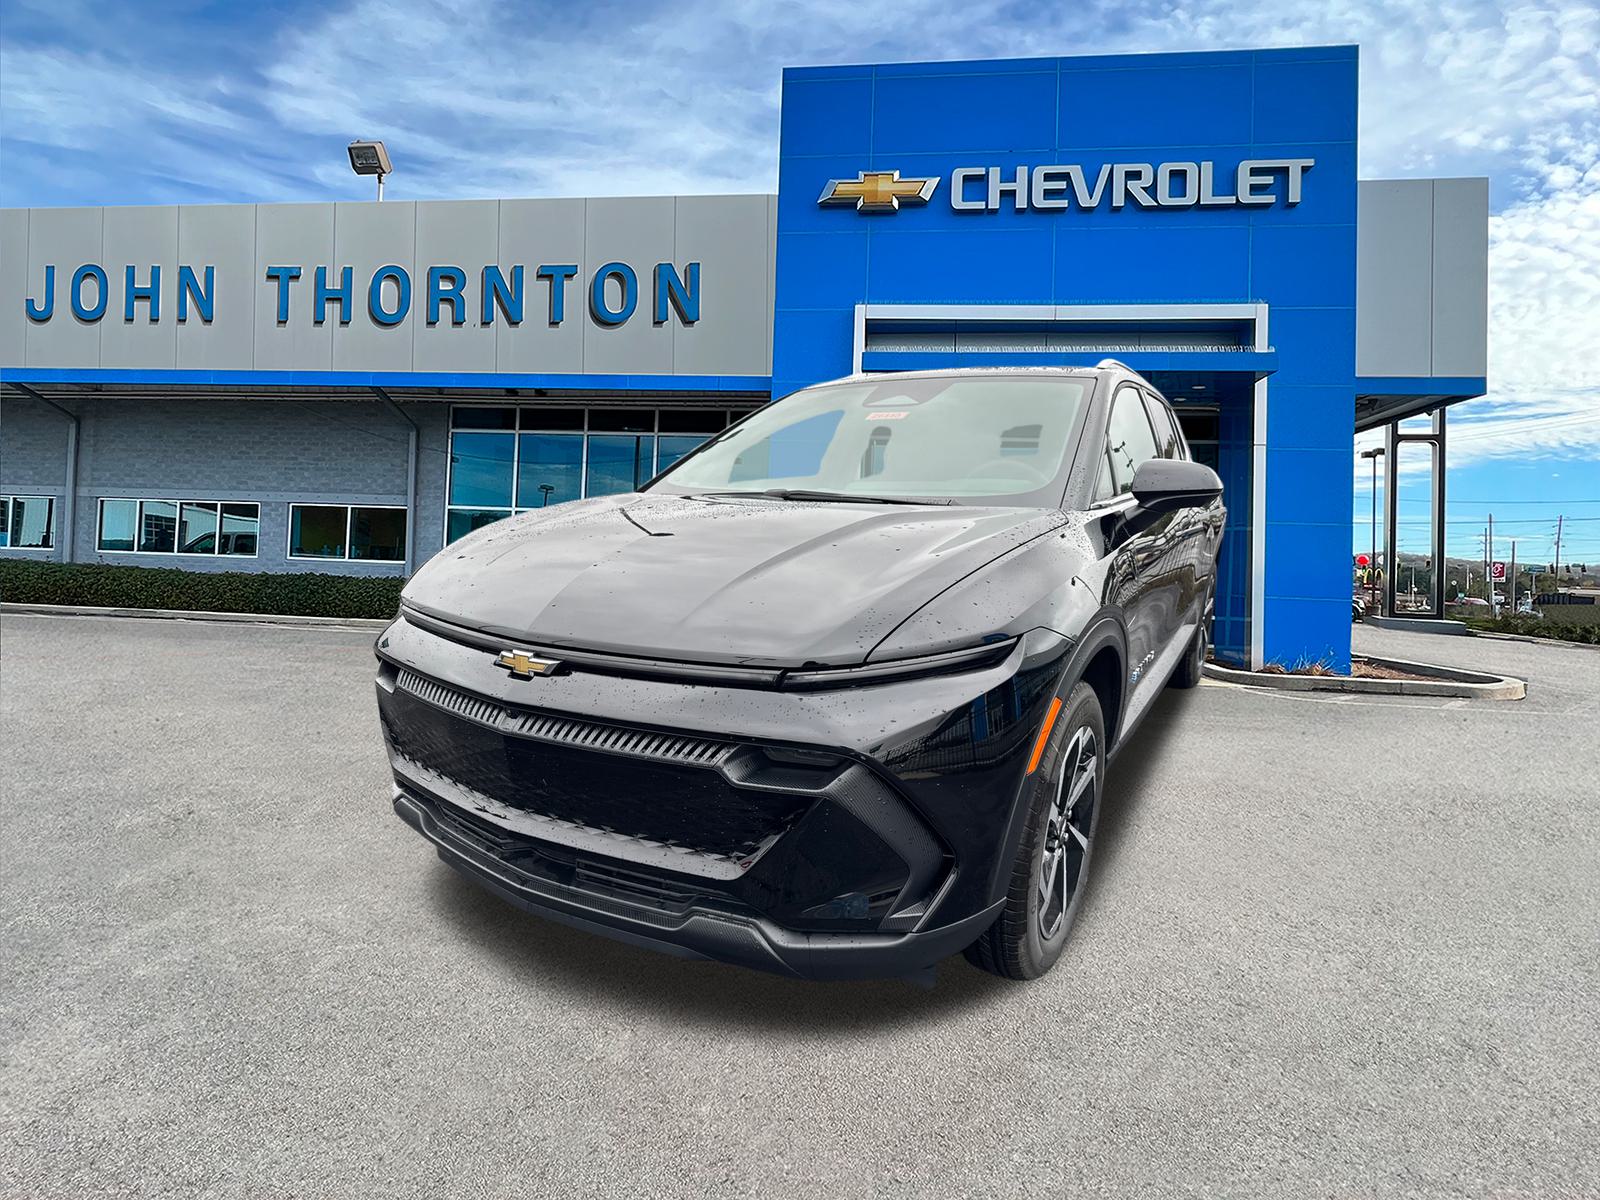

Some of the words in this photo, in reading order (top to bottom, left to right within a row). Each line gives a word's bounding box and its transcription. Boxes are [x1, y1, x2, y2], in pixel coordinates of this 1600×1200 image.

[950, 158, 1315, 211] CHEVROLET
[25, 263, 215, 323] JOHN
[265, 262, 701, 328] THORNTON
